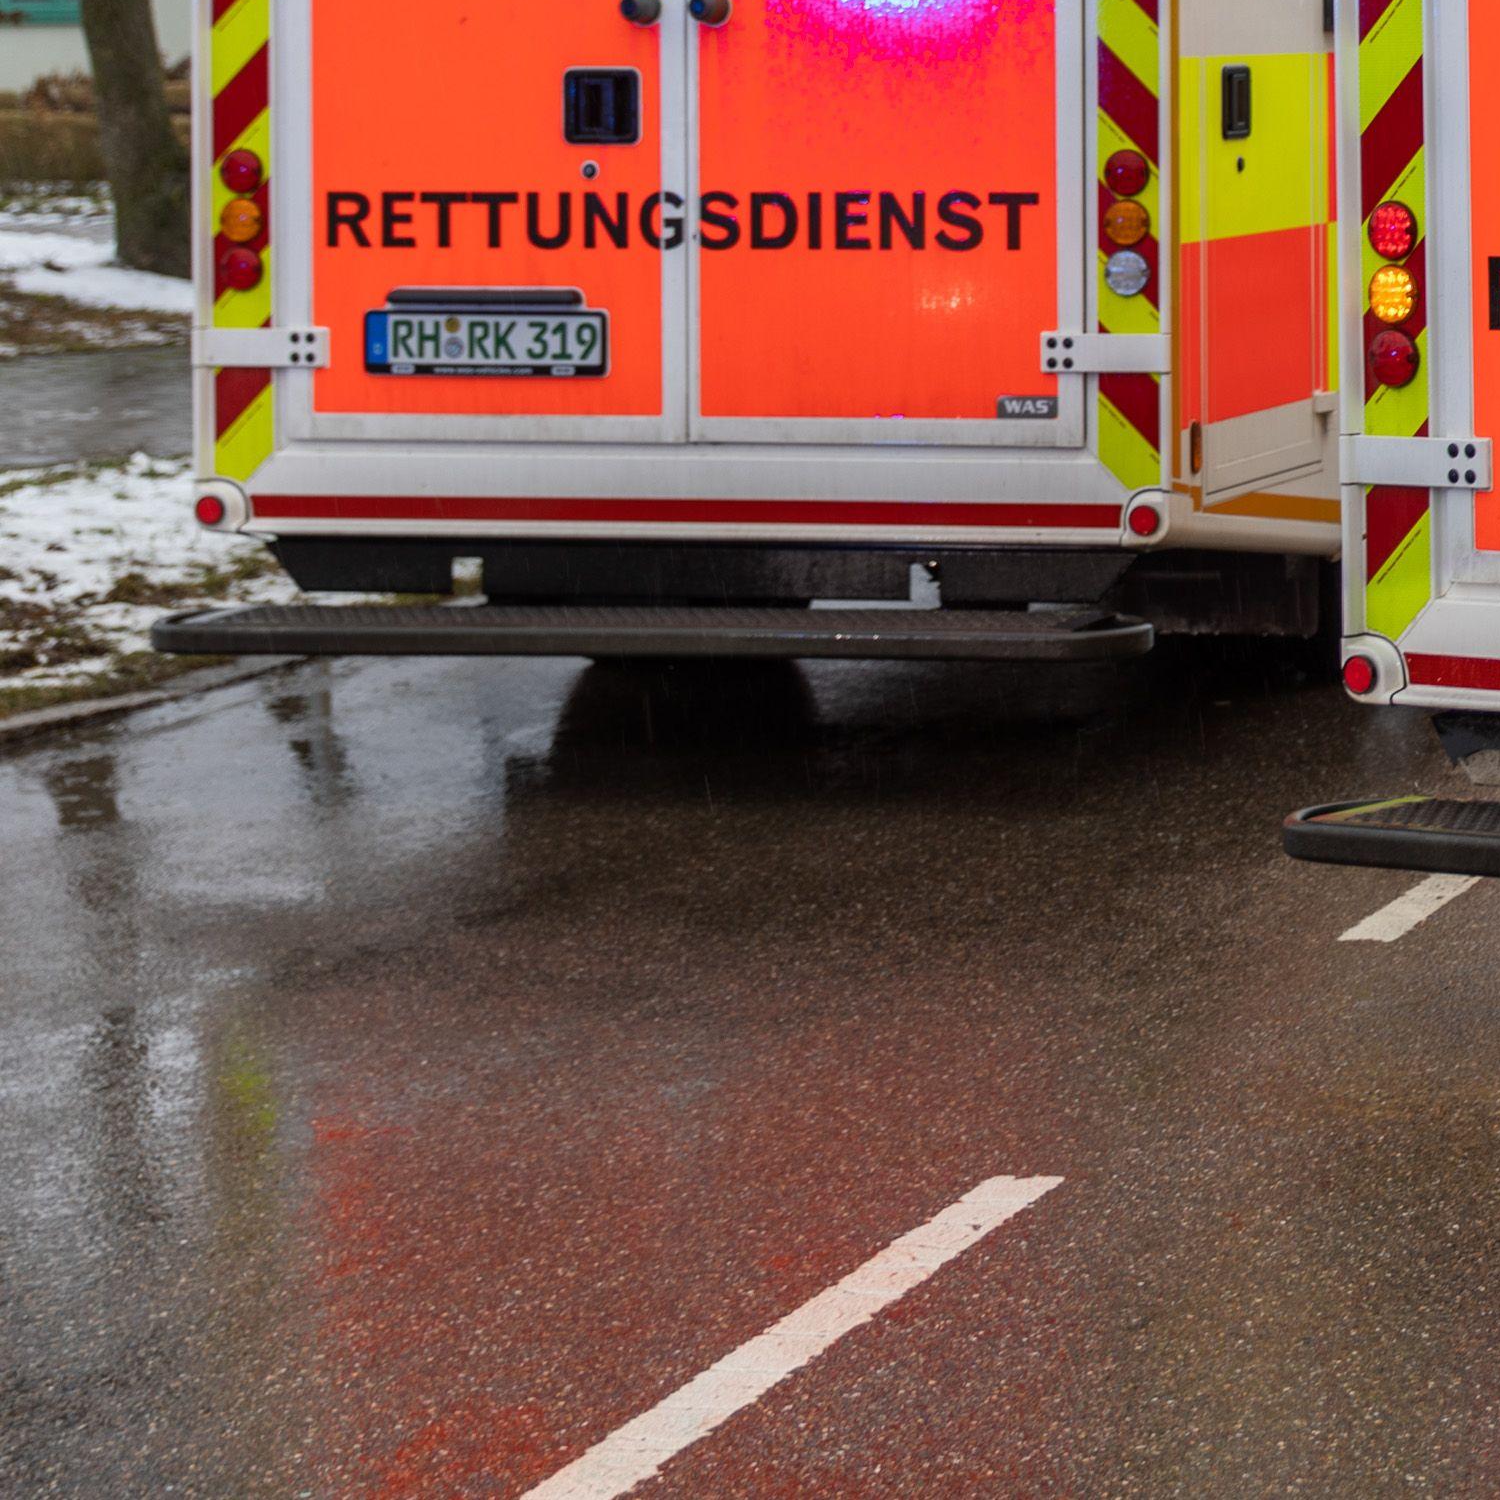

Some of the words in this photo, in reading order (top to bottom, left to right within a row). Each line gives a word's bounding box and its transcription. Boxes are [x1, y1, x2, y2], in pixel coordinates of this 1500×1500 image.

[325, 191, 1040, 250] RETTUNGSDIENST
[391, 319, 441, 359] RH
[467, 320, 517, 360] RK
[526, 321, 599, 361] 319
[1004, 399, 1049, 414] WAS
